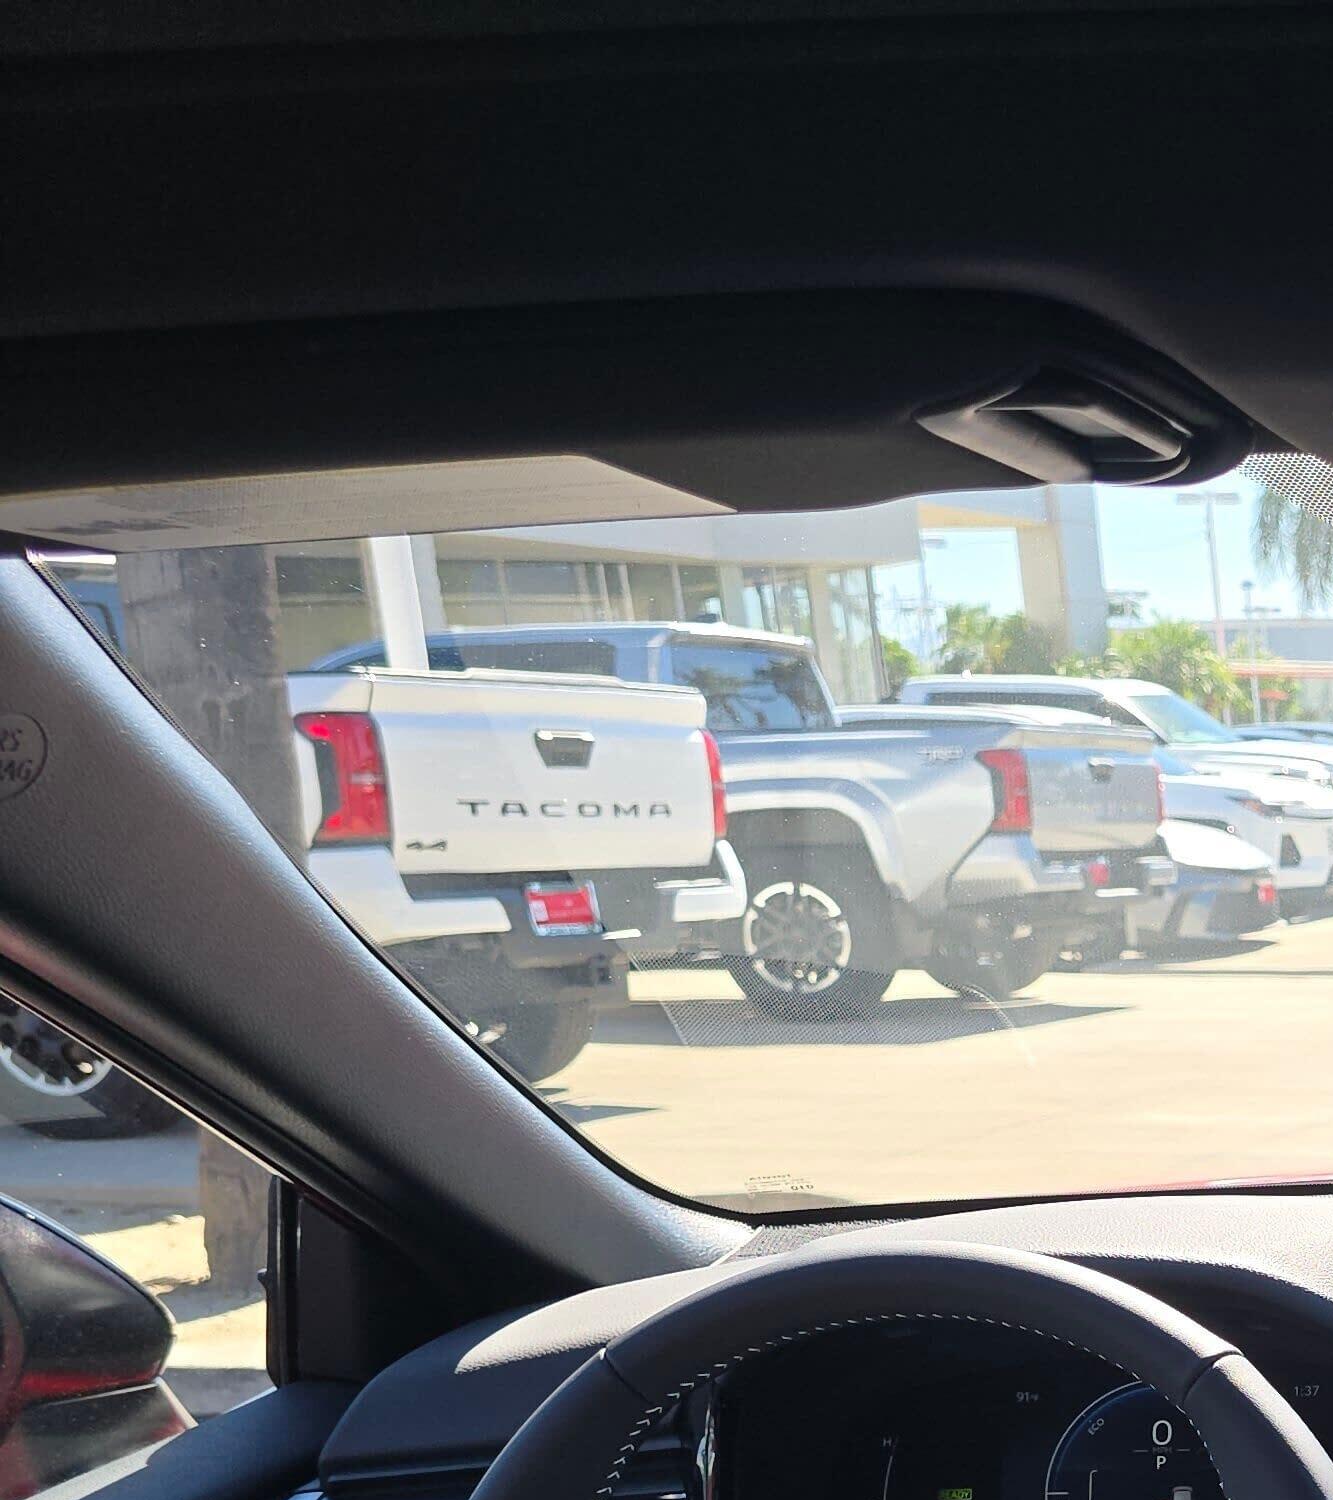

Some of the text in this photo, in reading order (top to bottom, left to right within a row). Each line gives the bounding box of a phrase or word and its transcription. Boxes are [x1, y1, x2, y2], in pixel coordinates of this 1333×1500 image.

[456, 798, 672, 818] TACOMA
[1294, 1385, 1320, 1397] 1:37
[1151, 1419, 1173, 1447] 0
[1156, 1456, 1167, 1470] P
